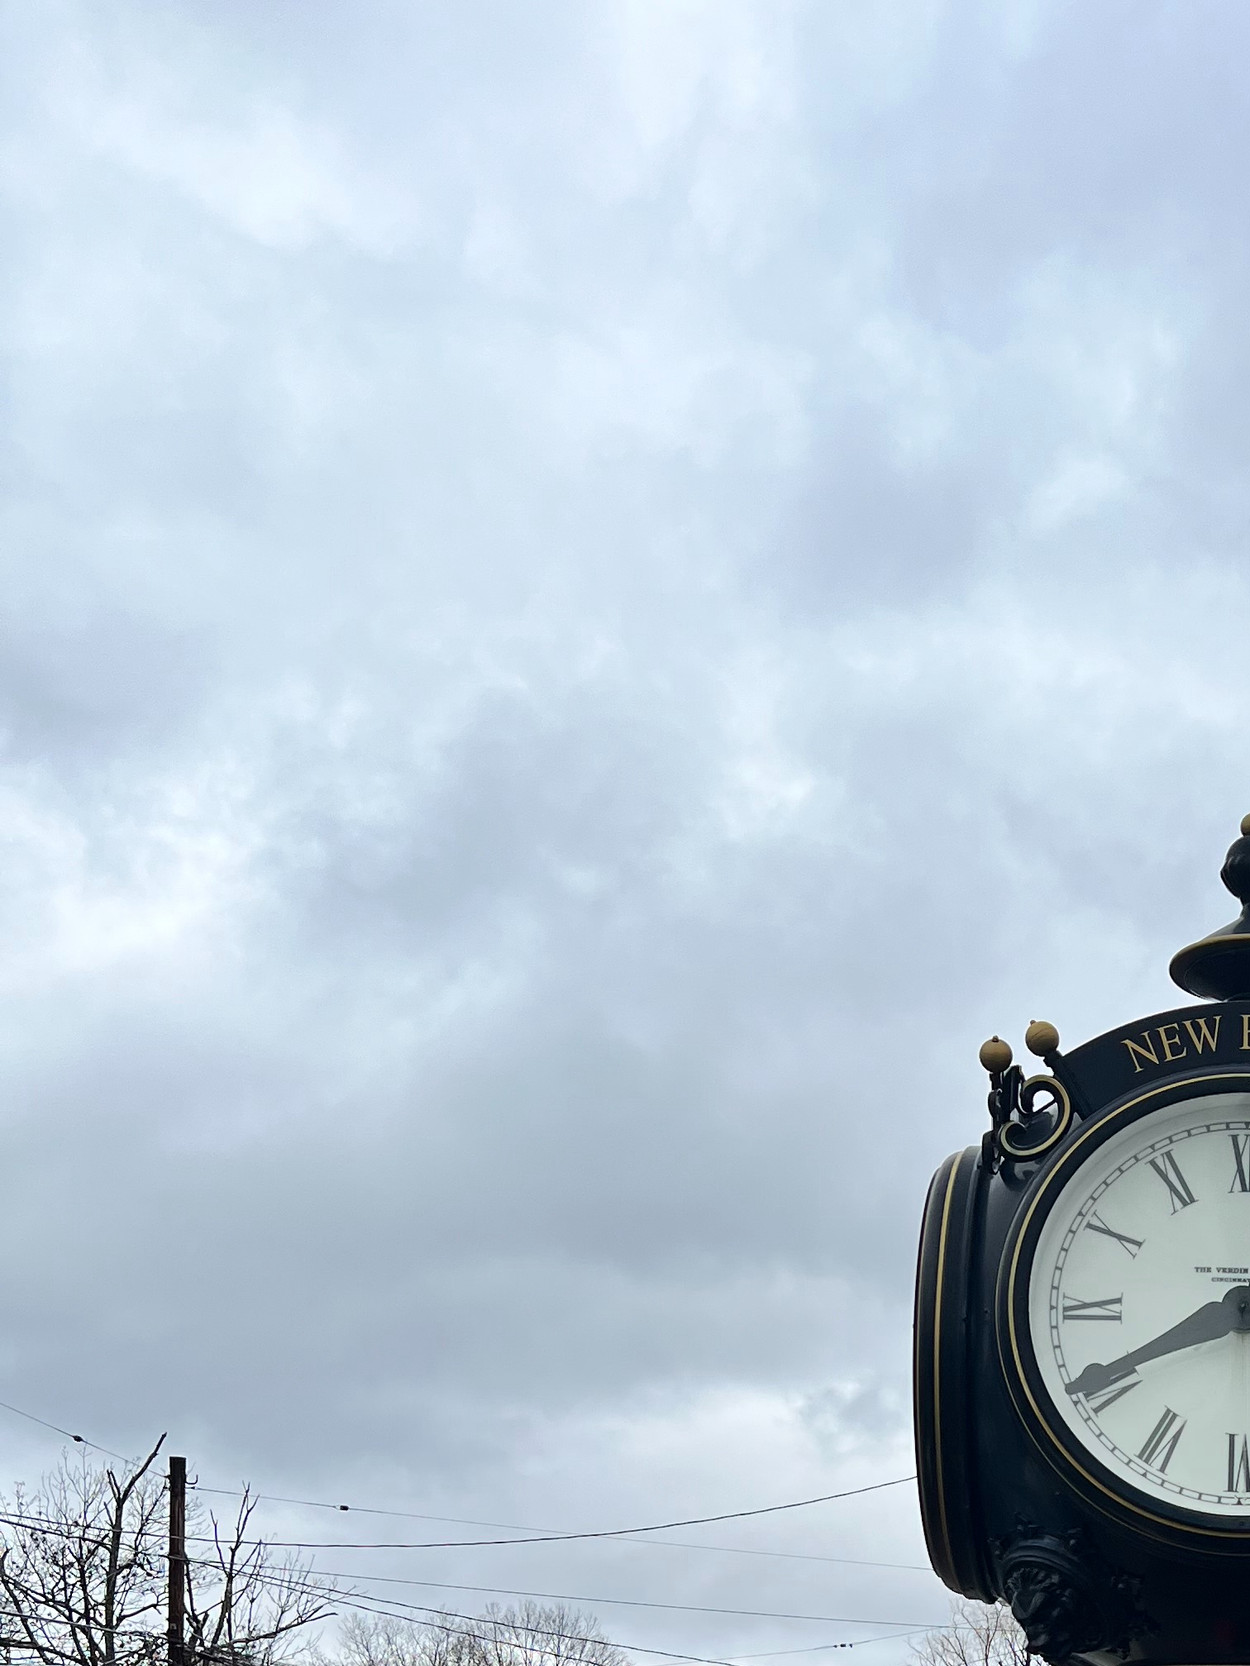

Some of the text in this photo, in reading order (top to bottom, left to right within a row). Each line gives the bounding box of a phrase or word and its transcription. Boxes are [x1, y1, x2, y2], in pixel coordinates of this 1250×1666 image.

[1120, 1015, 1222, 1074] NEW
[1144, 1149, 1200, 1216] XI
[1085, 1211, 1146, 1259] X
[1216, 1266, 1249, 1274] VERDIN
[1062, 1292, 1124, 1325] IX
[1133, 1404, 1187, 1476] VII
